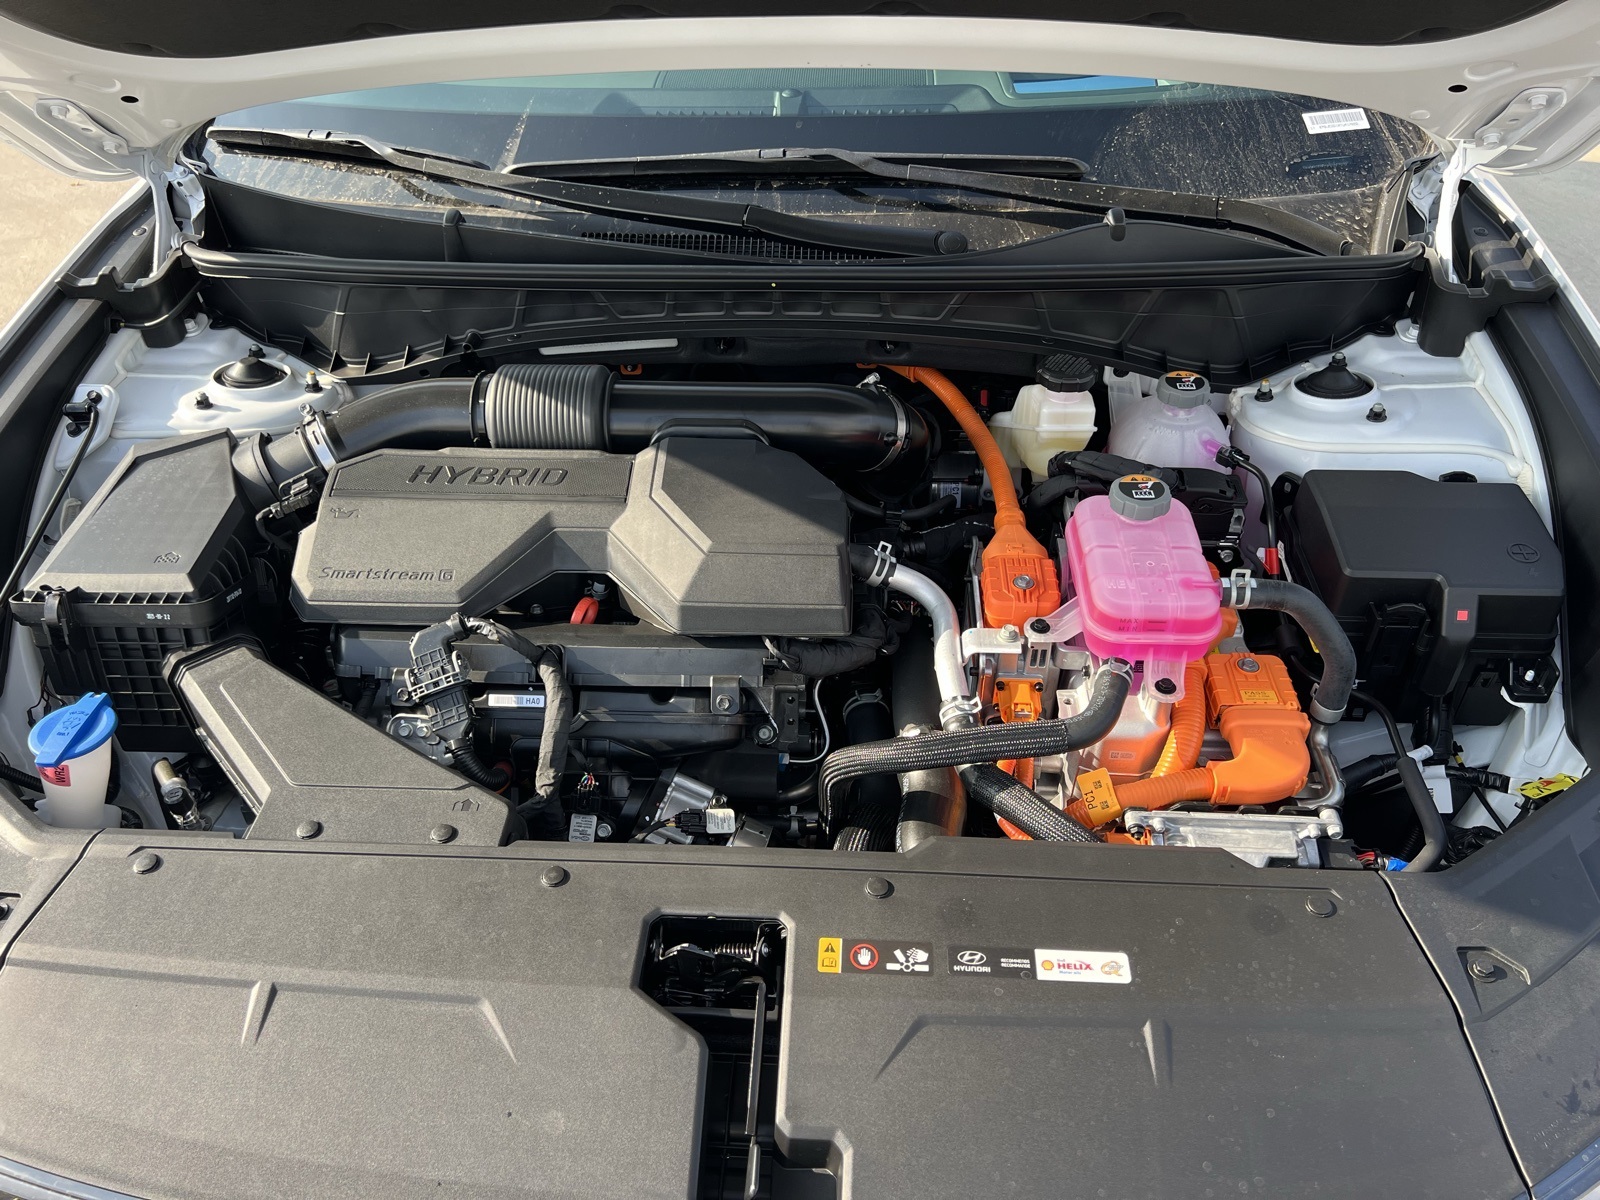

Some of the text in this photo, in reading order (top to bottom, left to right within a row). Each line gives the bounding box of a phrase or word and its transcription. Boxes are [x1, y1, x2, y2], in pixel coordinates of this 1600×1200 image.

[406, 465, 568, 486] HYBRID
[318, 566, 435, 581] Smartstream
[1084, 790, 1098, 811] PC1
[953, 965, 992, 973] HYUNDAI
[1057, 961, 1095, 971] HELIX
